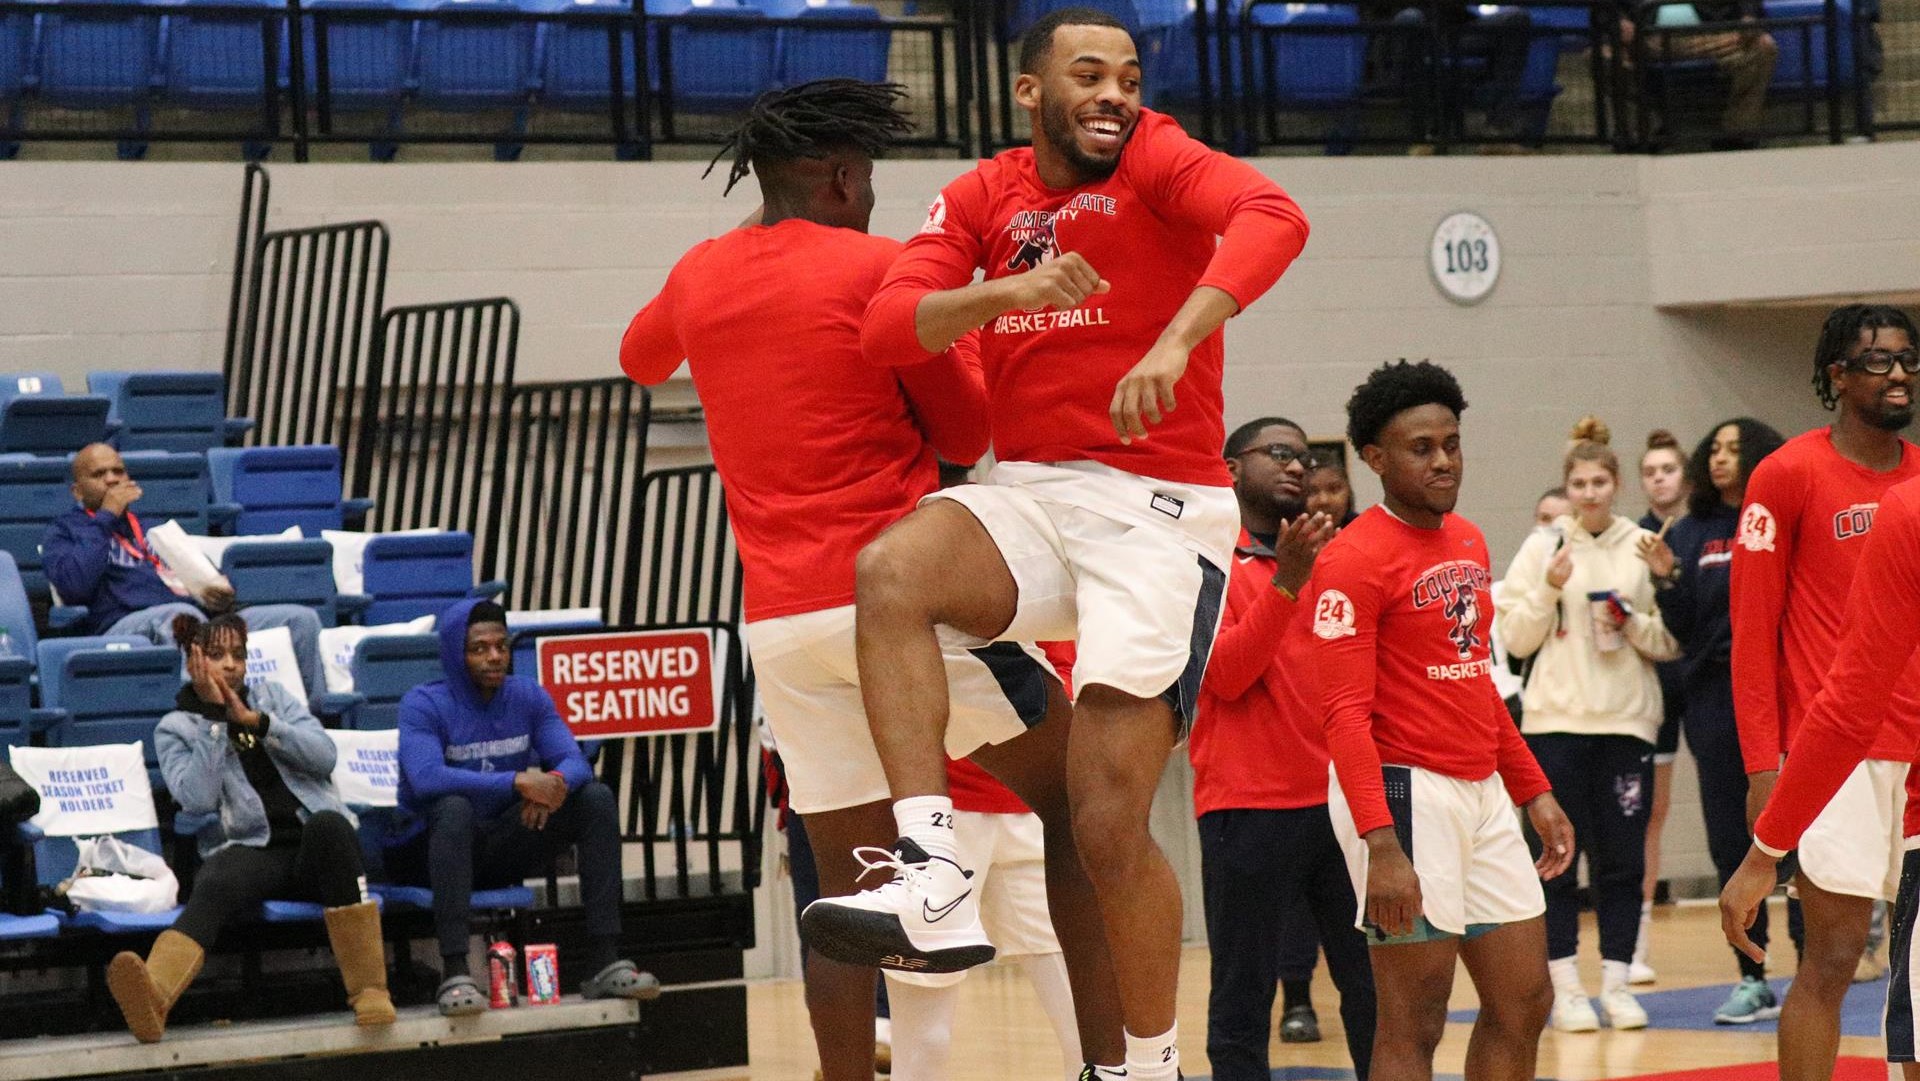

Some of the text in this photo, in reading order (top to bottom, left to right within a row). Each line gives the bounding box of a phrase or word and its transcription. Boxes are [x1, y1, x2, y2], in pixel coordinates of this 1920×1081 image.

[1445, 239, 1489, 273] 103
[994, 308, 1110, 334] BASKETBALL
[1319, 598, 1345, 622] 24
[552, 646, 700, 685] RESERVED
[566, 685, 690, 724] SEATING
[48, 767, 109, 783] RESERVED
[347, 761, 391, 774] SEASON
[41, 779, 125, 797] SEASON TICKET
[59, 798, 114, 812] HOLDERS
[931, 812, 953, 830] 23
